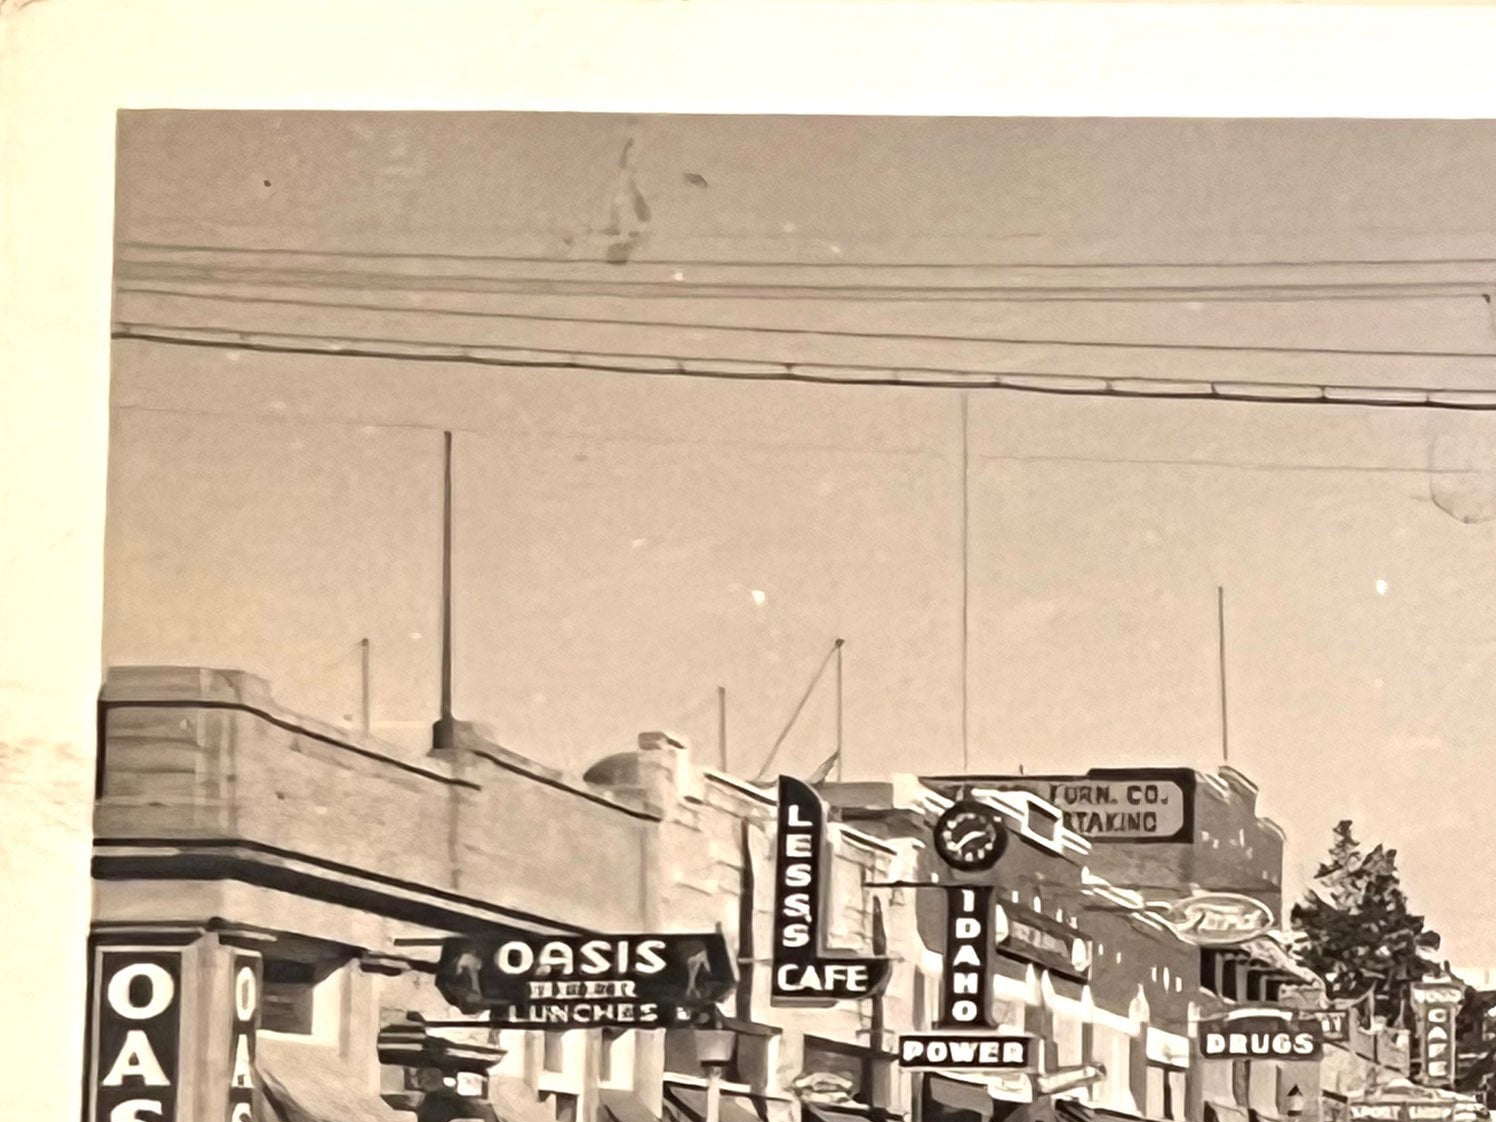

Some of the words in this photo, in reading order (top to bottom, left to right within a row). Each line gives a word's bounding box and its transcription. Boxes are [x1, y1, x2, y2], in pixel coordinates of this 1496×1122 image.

[1127, 784, 1169, 805] CO.
[496, 940, 668, 976] OASIS
[951, 888, 982, 1023] IDAHO
[777, 964, 868, 993] CAFE
[508, 1004, 658, 1023] LUNCHES
[902, 1040, 1025, 1063] POWER
[1206, 1032, 1314, 1055] DRUGS
